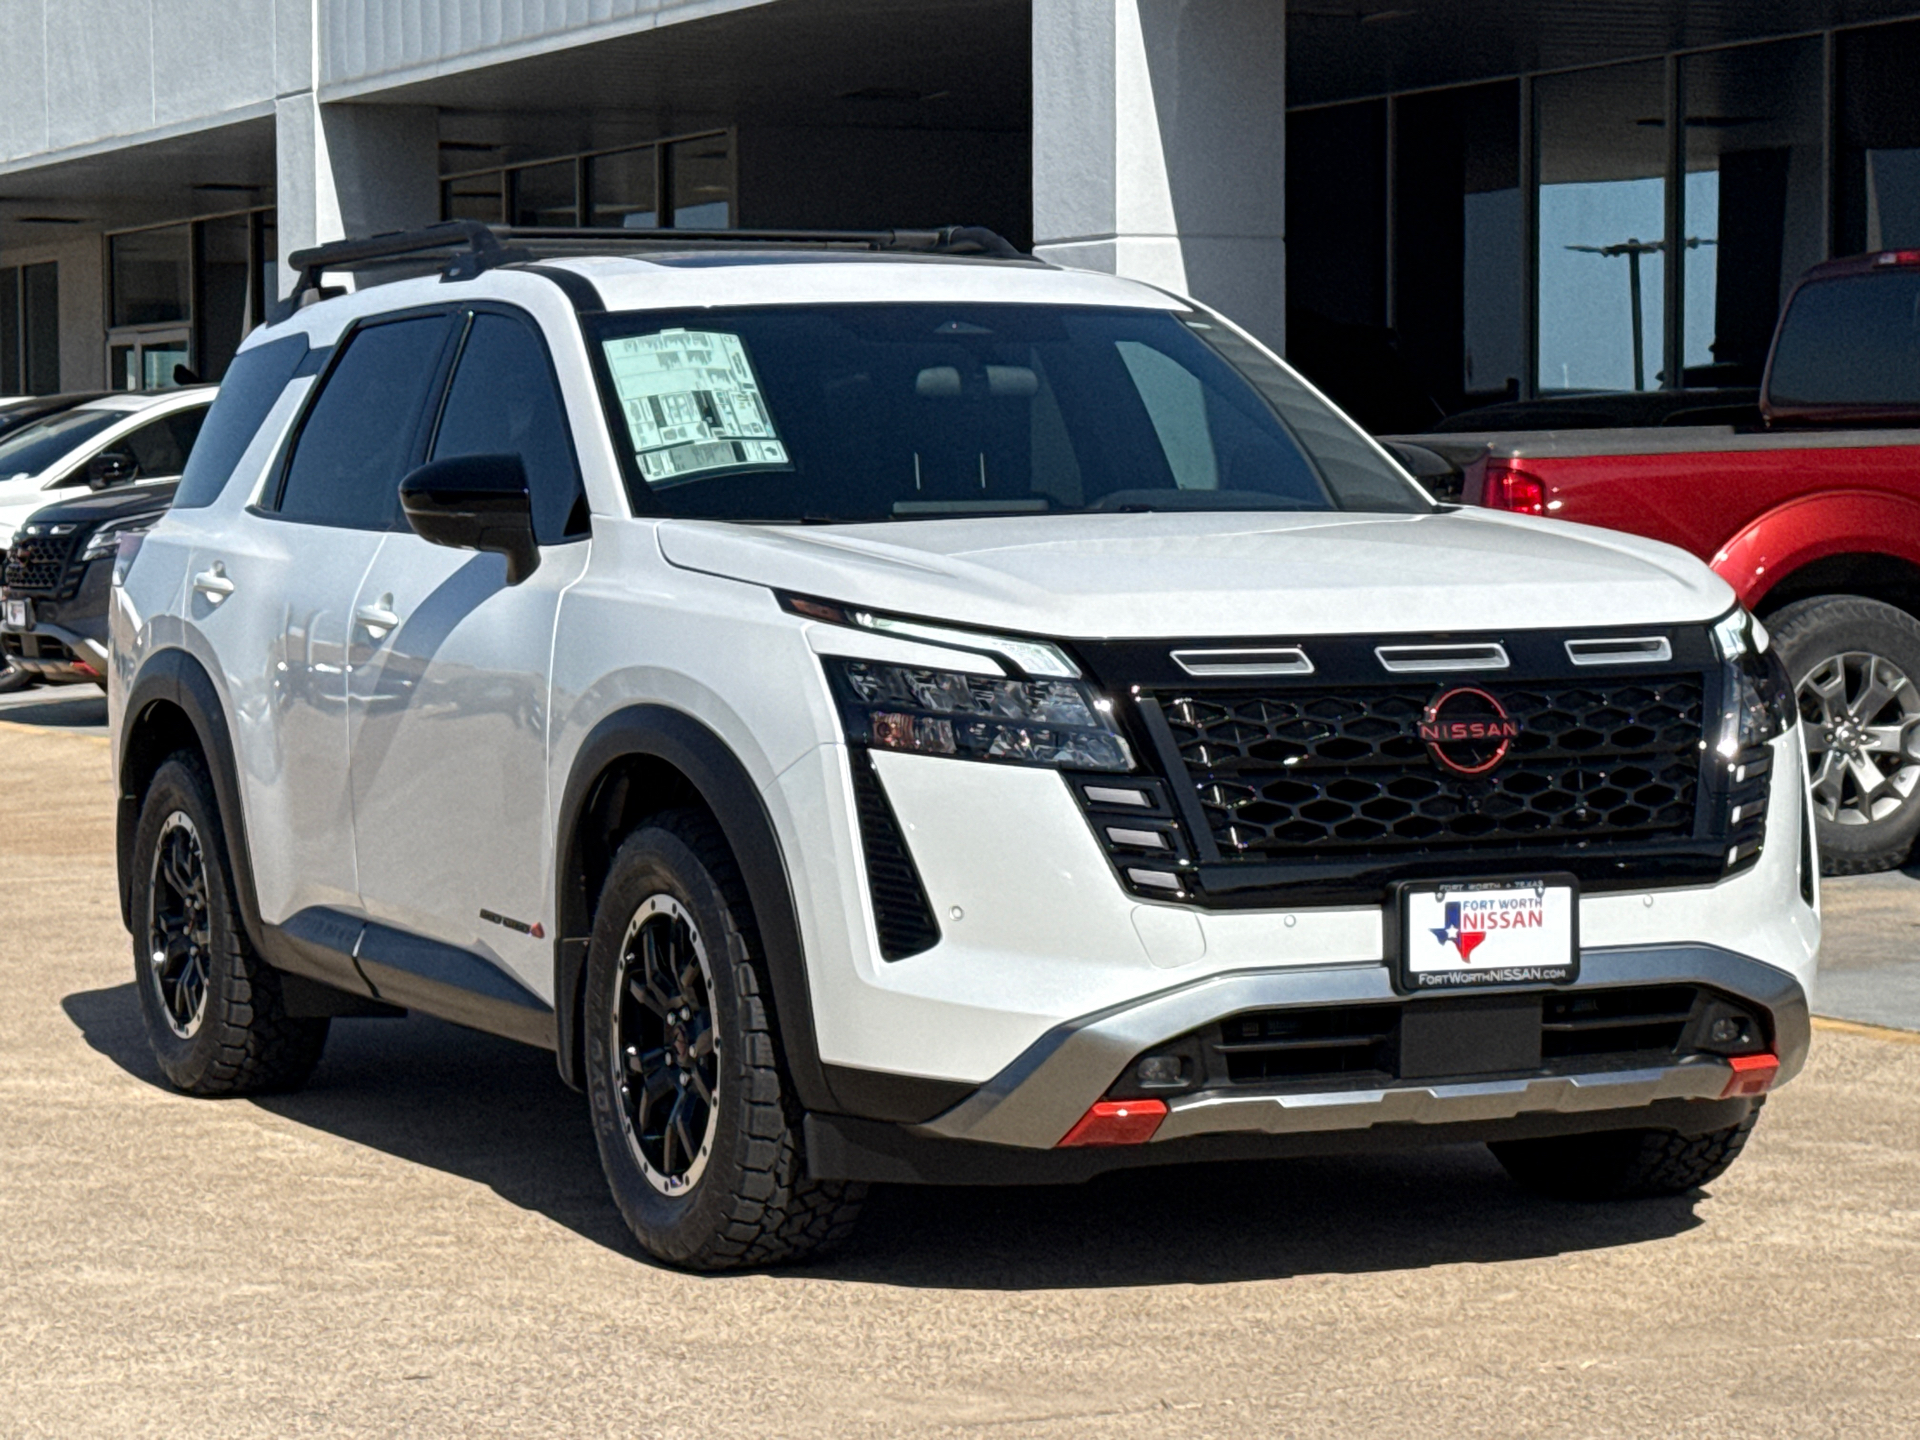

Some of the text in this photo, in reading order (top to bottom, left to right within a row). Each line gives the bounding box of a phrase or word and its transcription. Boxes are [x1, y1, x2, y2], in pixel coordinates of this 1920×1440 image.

[1420, 722, 1517, 739] NISSAN
[1514, 880, 1544, 888] TEXAS
[1463, 898, 1542, 911] FORT WORTH
[1463, 909, 1543, 930] NISSAN
